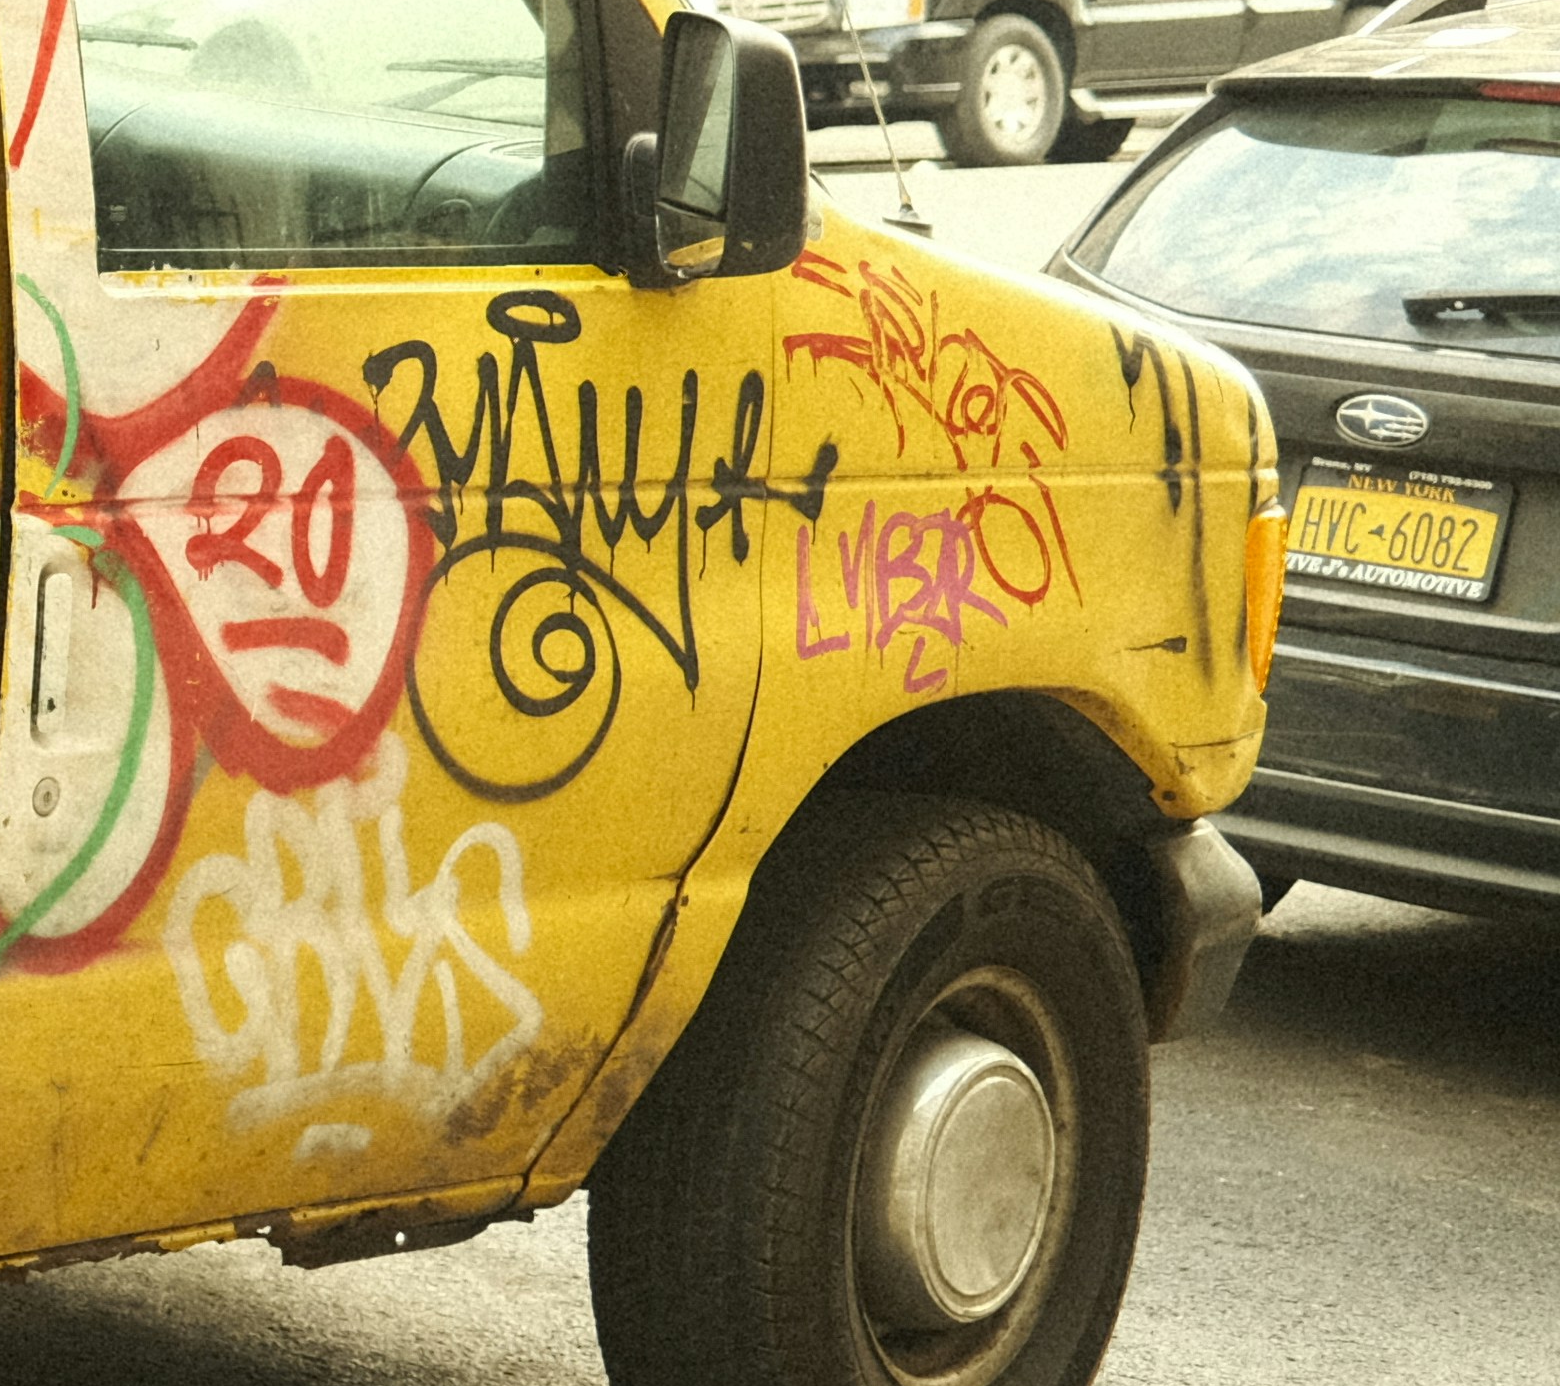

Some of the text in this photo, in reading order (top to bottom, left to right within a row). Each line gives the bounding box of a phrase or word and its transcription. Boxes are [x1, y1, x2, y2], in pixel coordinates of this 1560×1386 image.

[1348, 474, 1457, 503] NEW YORK
[1299, 496, 1480, 572] HVC 6082
[1349, 564, 1486, 599] AUTOMOTIVE
